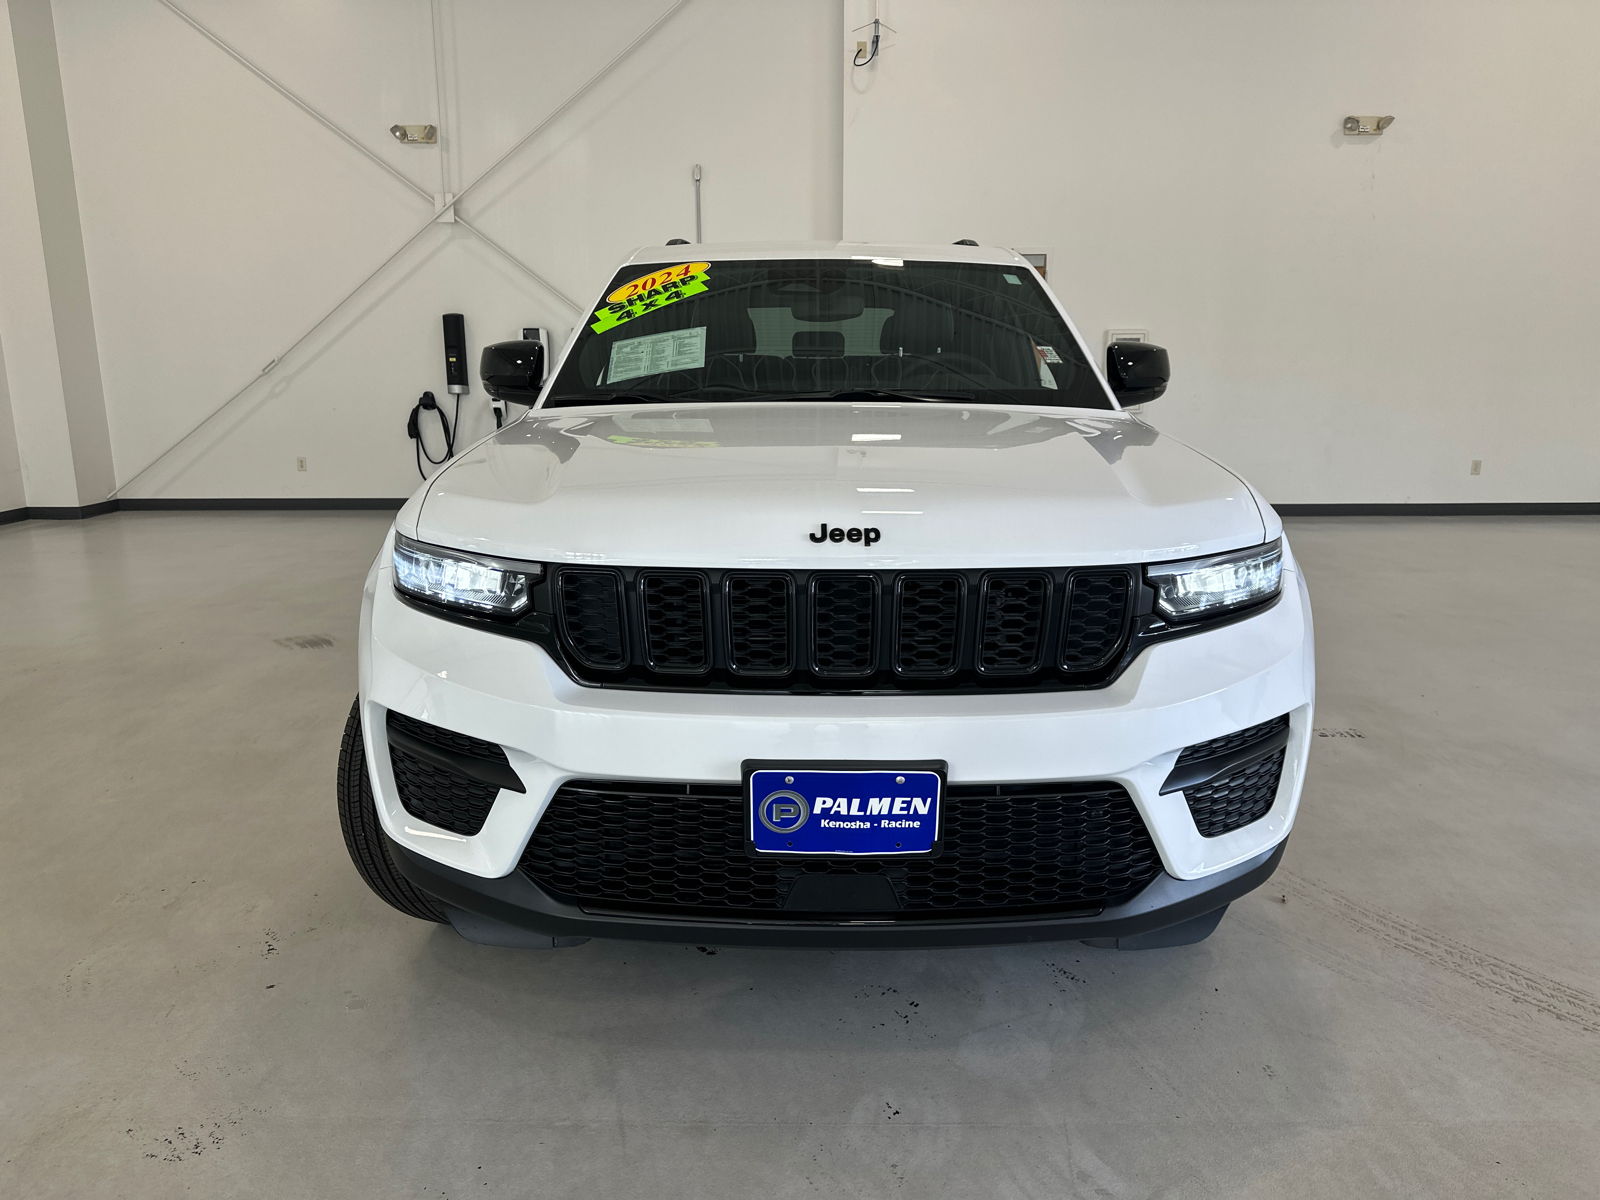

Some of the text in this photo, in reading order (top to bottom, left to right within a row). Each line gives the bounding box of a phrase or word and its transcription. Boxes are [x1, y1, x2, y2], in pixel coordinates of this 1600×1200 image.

[625, 264, 691, 299] 2024
[608, 275, 698, 314] SHARP
[809, 523, 881, 547] Jeep
[773, 803, 800, 822] P
[812, 797, 931, 816] PALMEN
[820, 819, 871, 829] Kenosha
[880, 819, 921, 829] Racine
